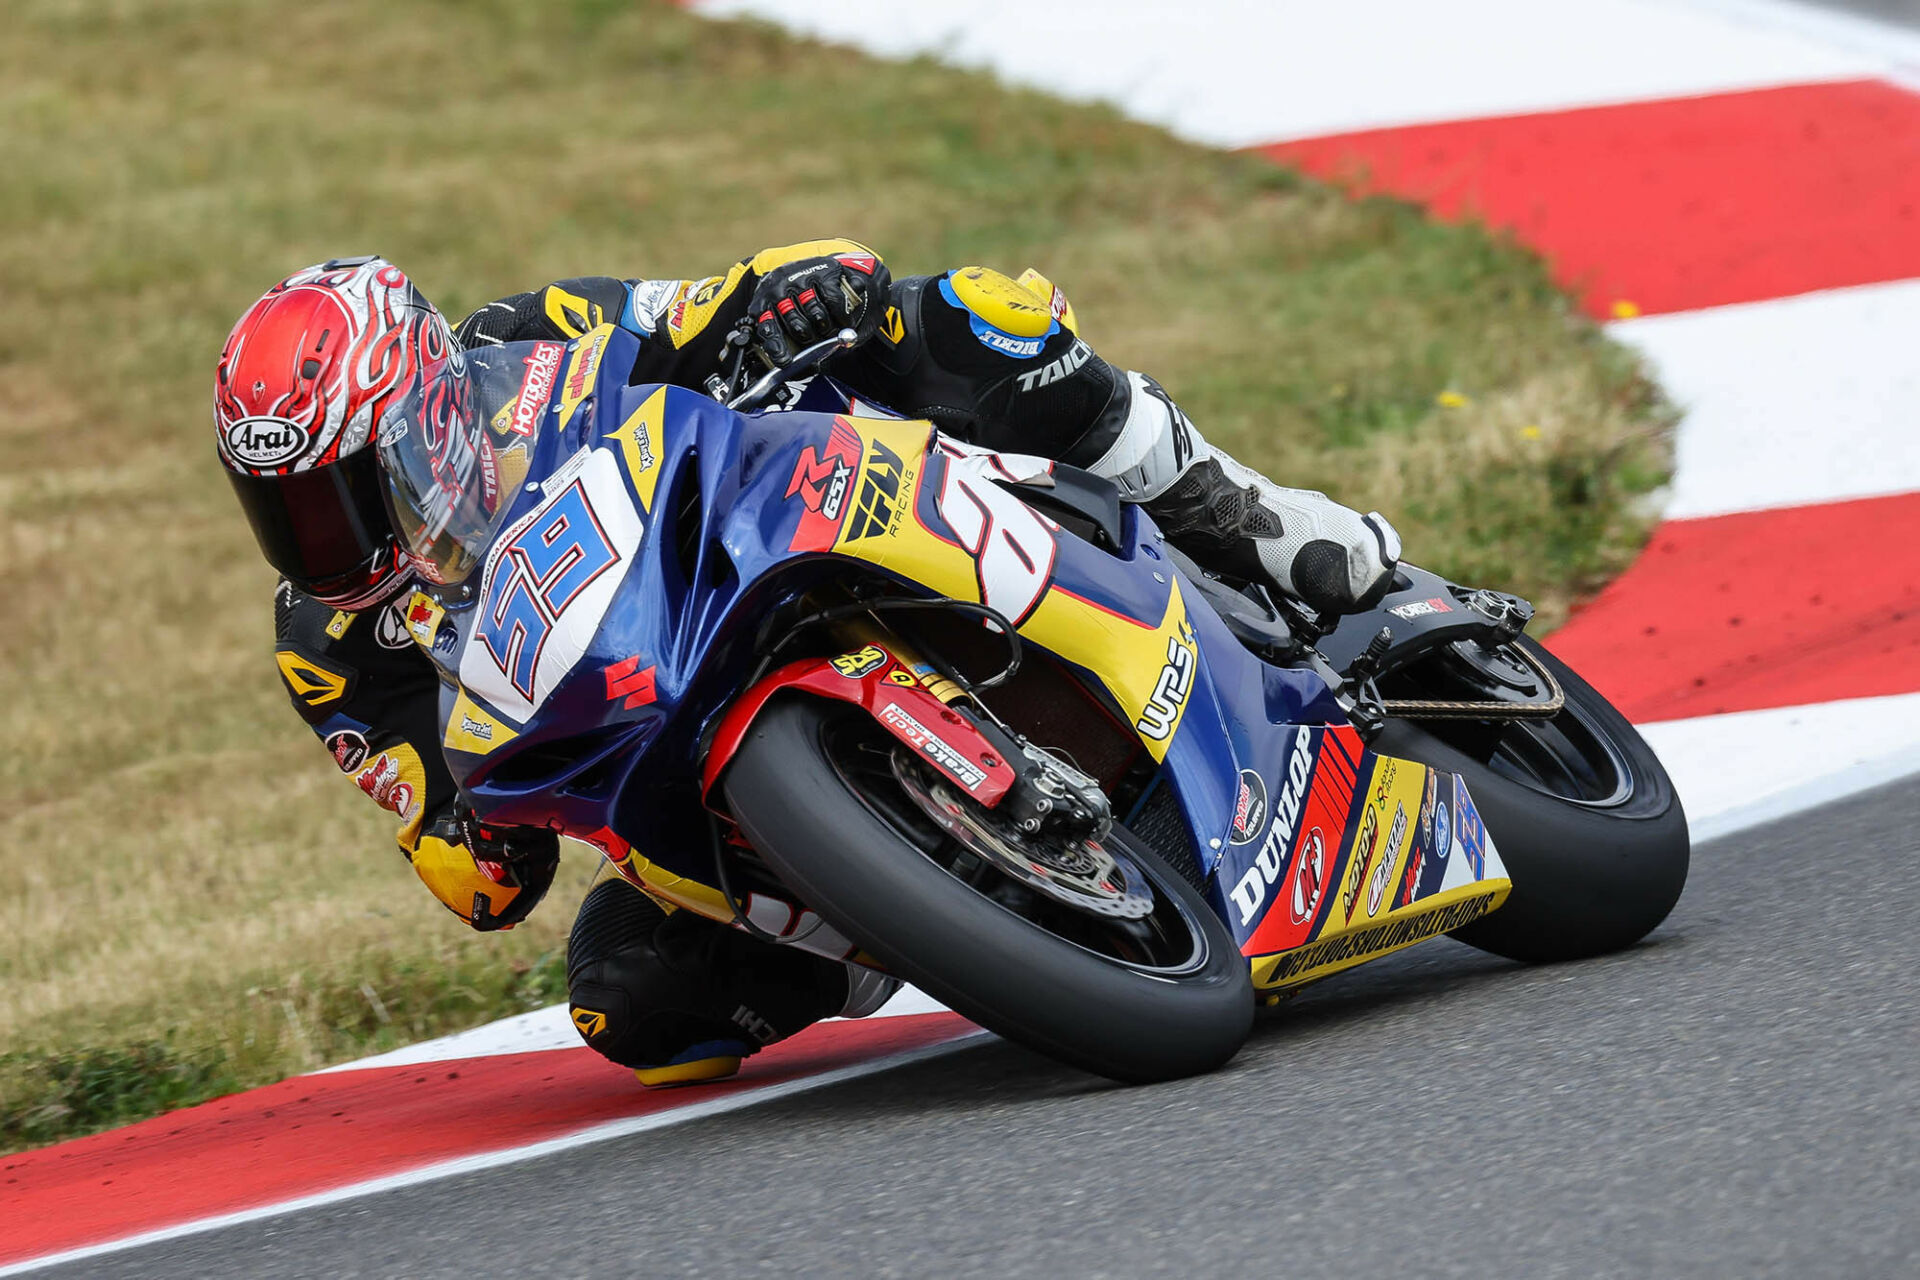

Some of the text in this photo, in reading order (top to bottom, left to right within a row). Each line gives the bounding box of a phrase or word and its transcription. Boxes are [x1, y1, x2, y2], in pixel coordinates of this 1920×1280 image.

[513, 343, 552, 434] HOTBODIES
[980, 330, 1040, 356] BICKLE
[231, 423, 294, 450] Arai
[822, 460, 854, 521] GSX
[845, 438, 904, 543] FLY
[889, 469, 915, 538] RACING
[474, 476, 622, 705] 59
[1136, 637, 1194, 741] WPS
[1229, 725, 1313, 927] DUNLOP
